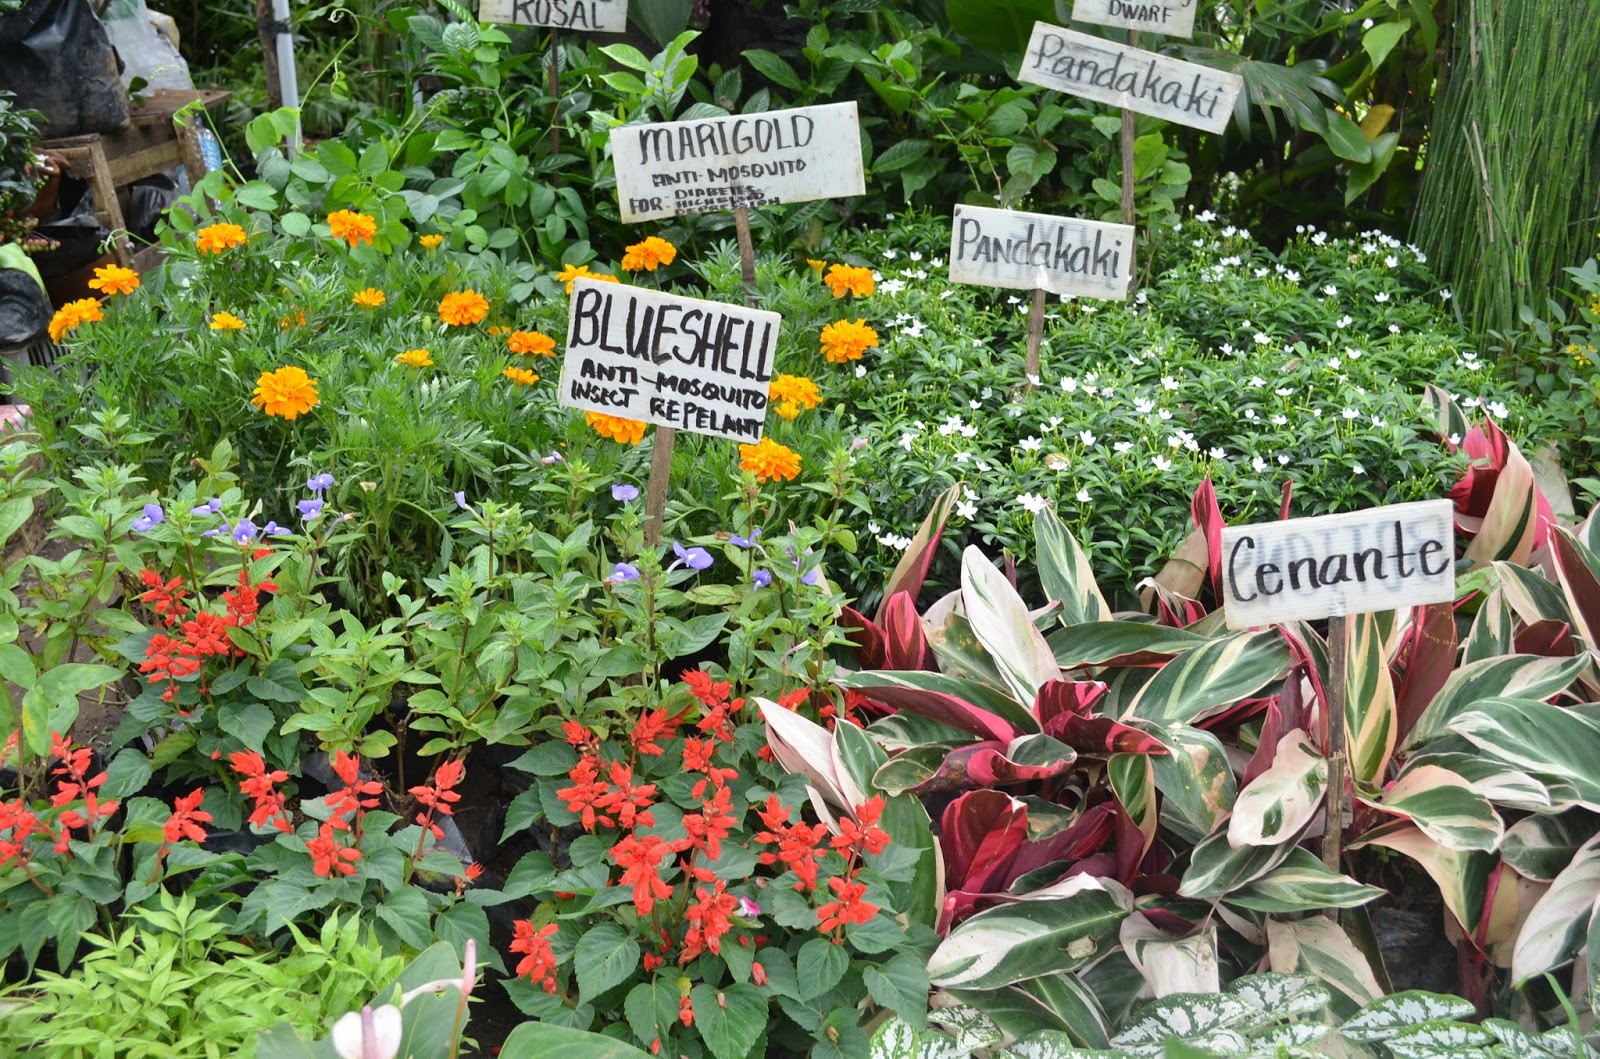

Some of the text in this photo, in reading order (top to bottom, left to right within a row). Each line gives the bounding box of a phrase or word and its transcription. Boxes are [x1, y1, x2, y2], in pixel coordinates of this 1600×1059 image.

[1108, 0, 1174, 24] DWARF
[1032, 33, 1224, 119] Pandakaki
[639, 114, 815, 165] MARIGOLD
[569, 288, 772, 382] BLUESHELL
[571, 380, 764, 440] INSECT REPELANT
[1228, 520, 1451, 602] Cenante
